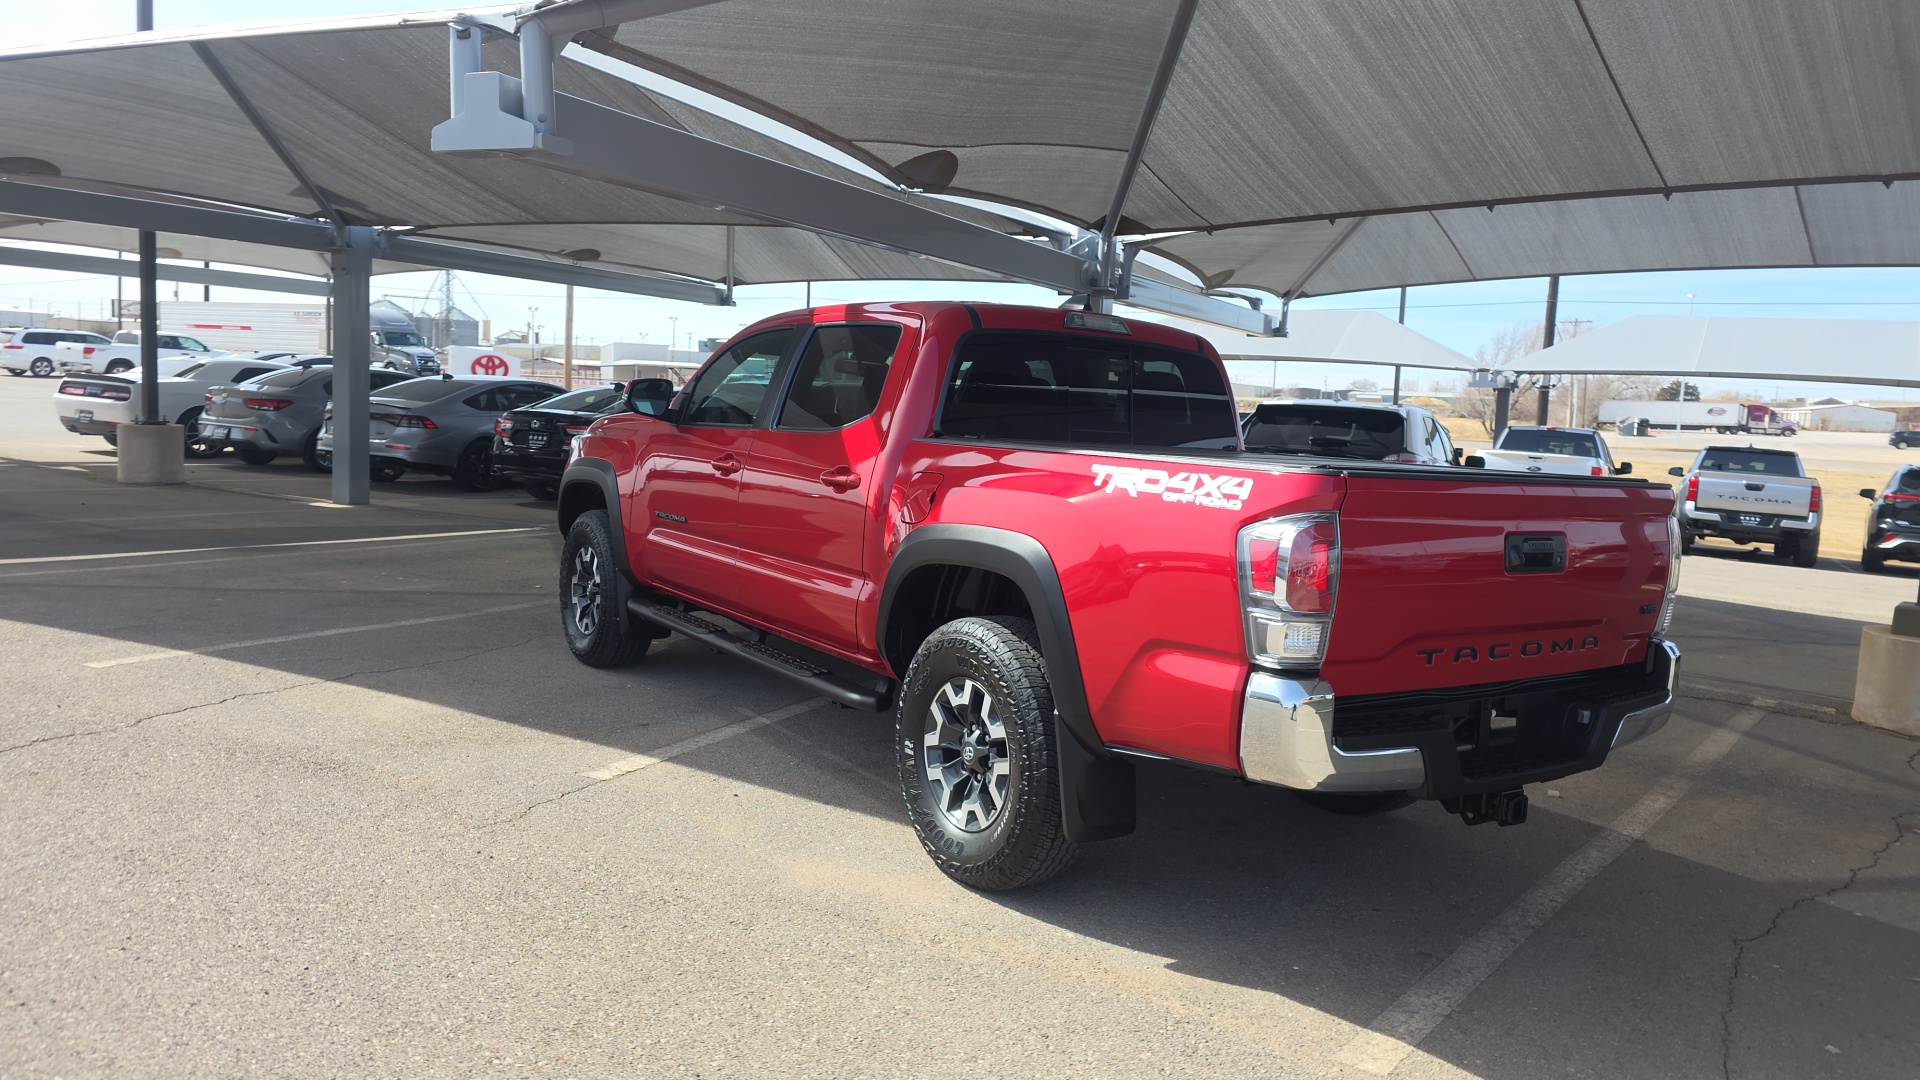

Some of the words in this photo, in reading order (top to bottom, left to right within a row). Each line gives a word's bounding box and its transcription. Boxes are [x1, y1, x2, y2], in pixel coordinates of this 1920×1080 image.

[1716, 494, 1792, 504] TACOMA
[655, 510, 687, 524] TACOMA
[1416, 635, 1600, 666] TACOMA
